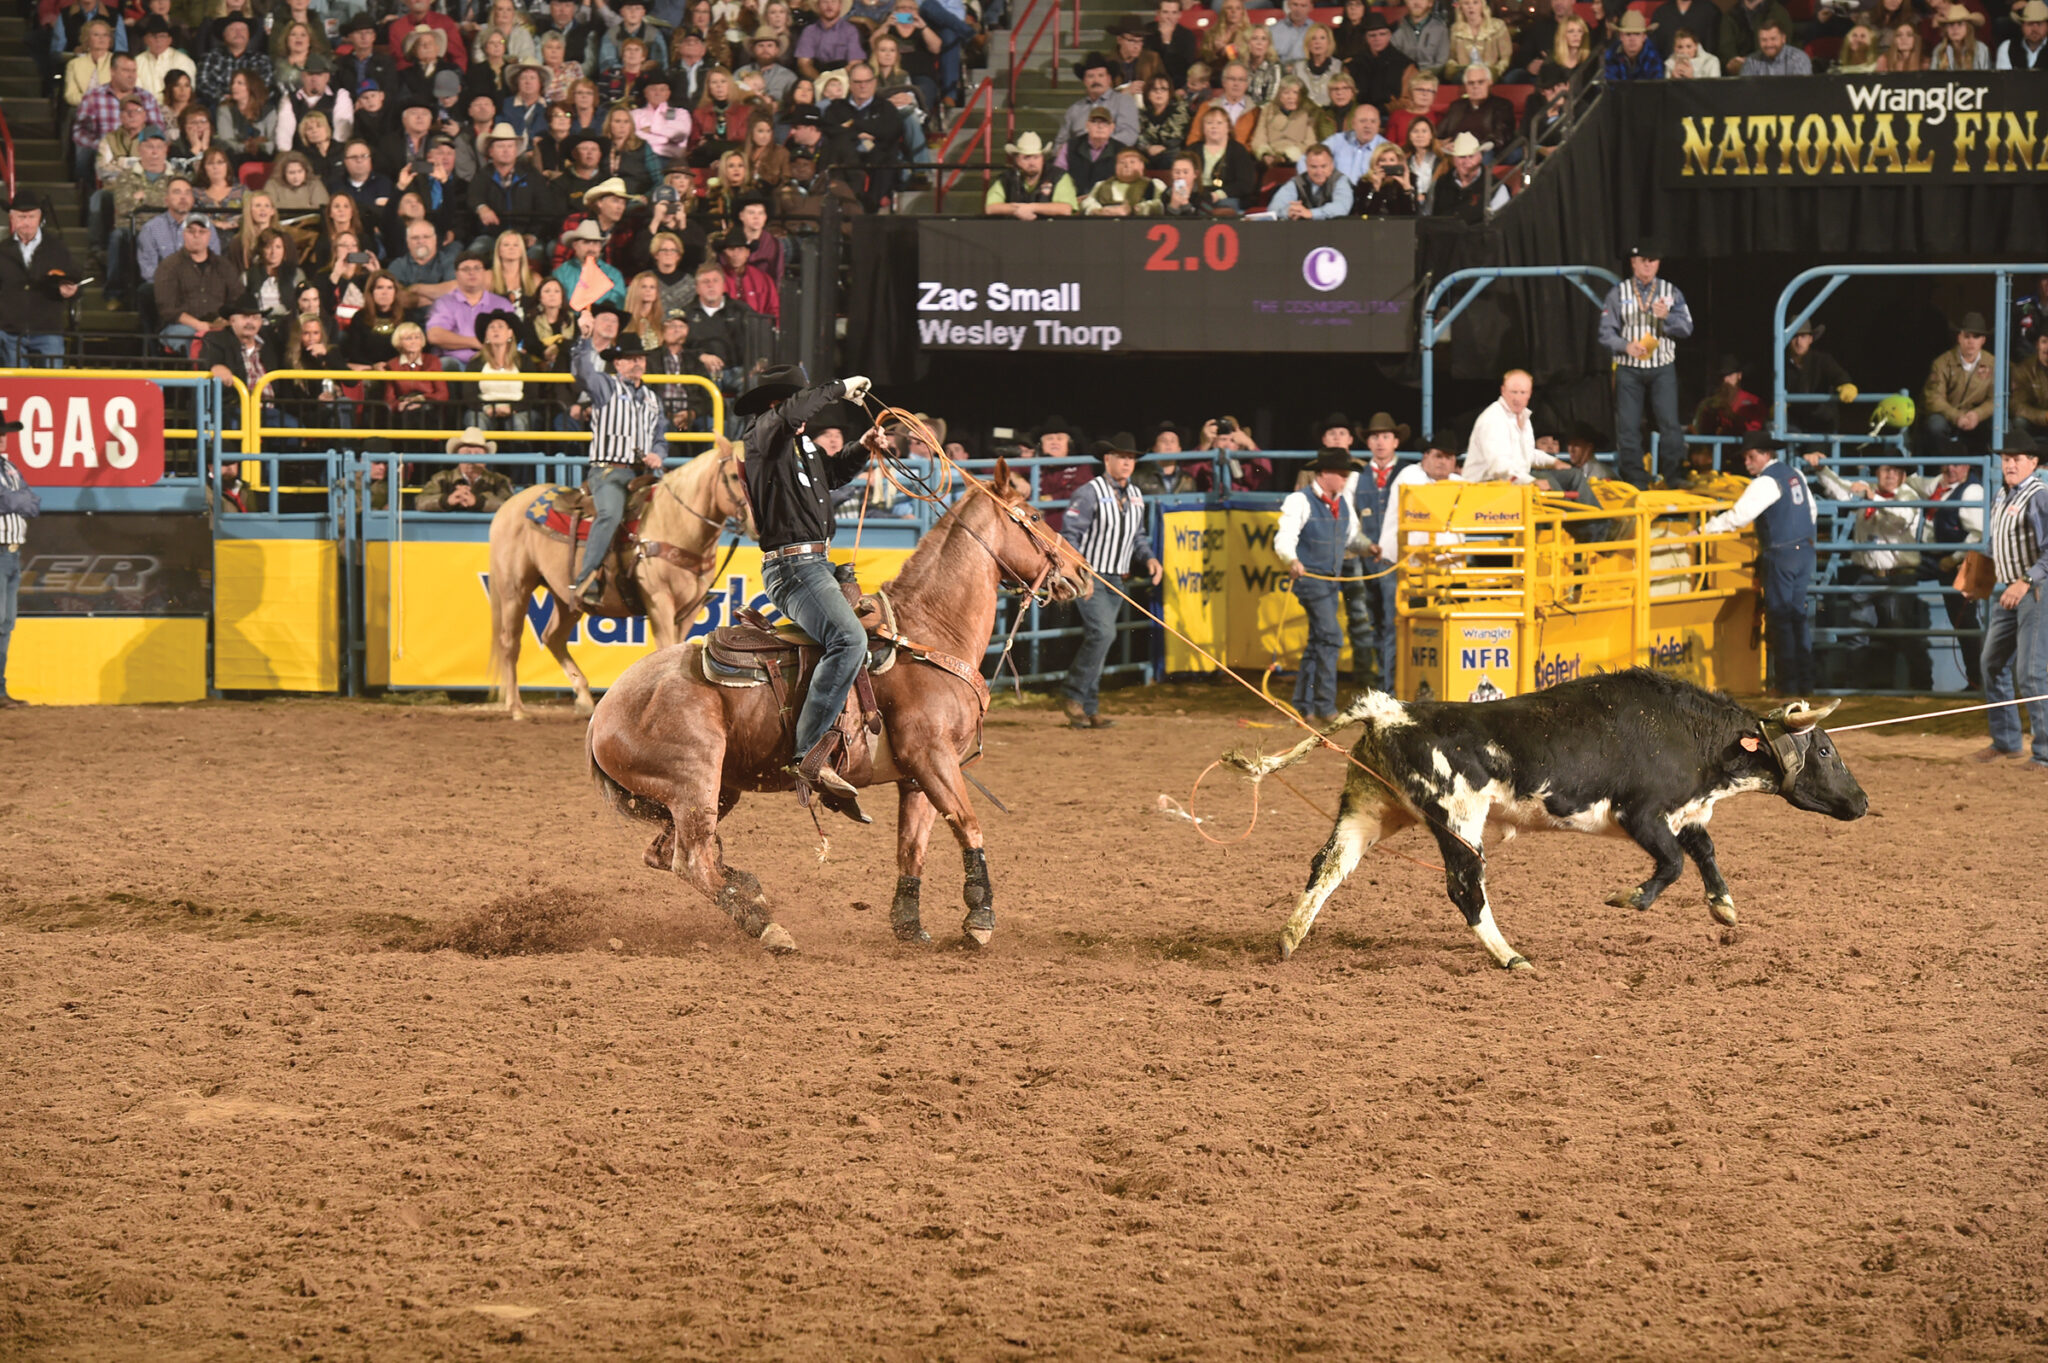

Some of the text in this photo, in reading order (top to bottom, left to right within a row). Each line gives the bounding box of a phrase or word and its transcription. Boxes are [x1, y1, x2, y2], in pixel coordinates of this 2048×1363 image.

[1846, 82, 1989, 126] Wrangler
[1681, 111, 2048, 176] NATIONAL FIN
[1144, 223, 1240, 271] 2.0
[916, 281, 1081, 312] Zac Small
[917, 318, 1123, 352] Wesley Thorp
[0, 395, 139, 470] GAS
[1474, 511, 1520, 521] Priefert
[20, 554, 159, 592] ER
[1462, 626, 1512, 644] Wrangler
[1649, 633, 1693, 667] riefert
[1411, 646, 1438, 668] NFR
[1461, 648, 1510, 669] NFR
[1535, 651, 1581, 688] riefert
